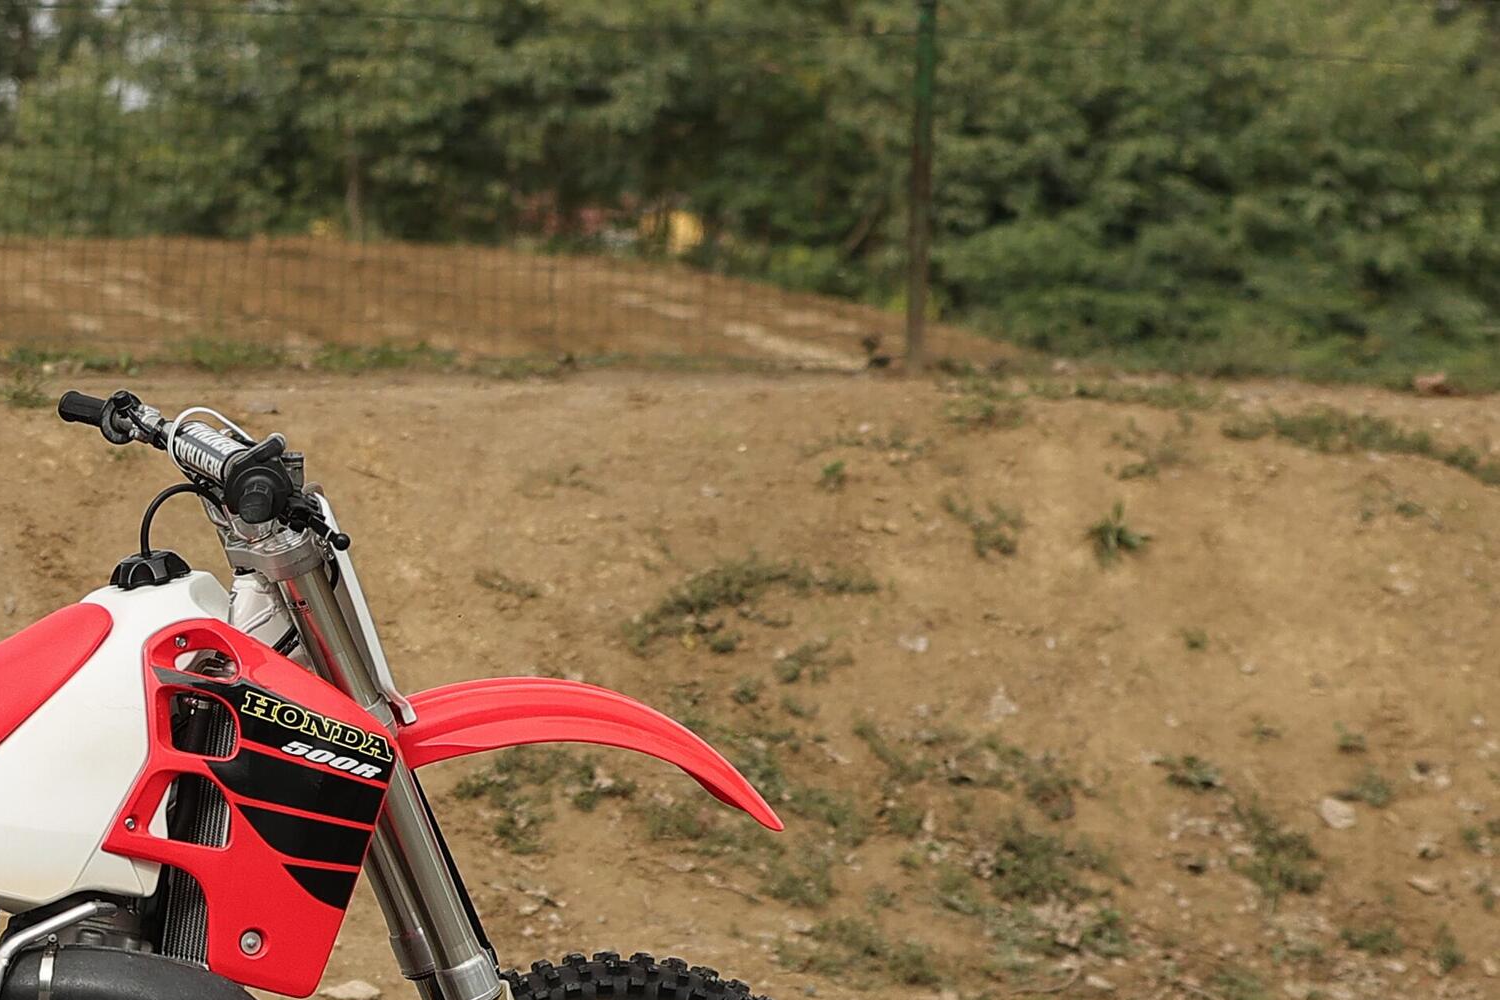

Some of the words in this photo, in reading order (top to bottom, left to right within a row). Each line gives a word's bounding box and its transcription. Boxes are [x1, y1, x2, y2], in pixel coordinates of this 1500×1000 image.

[174, 436, 224, 481] RENTHAL
[240, 691, 393, 762] HONDA
[281, 741, 382, 778] 500R
